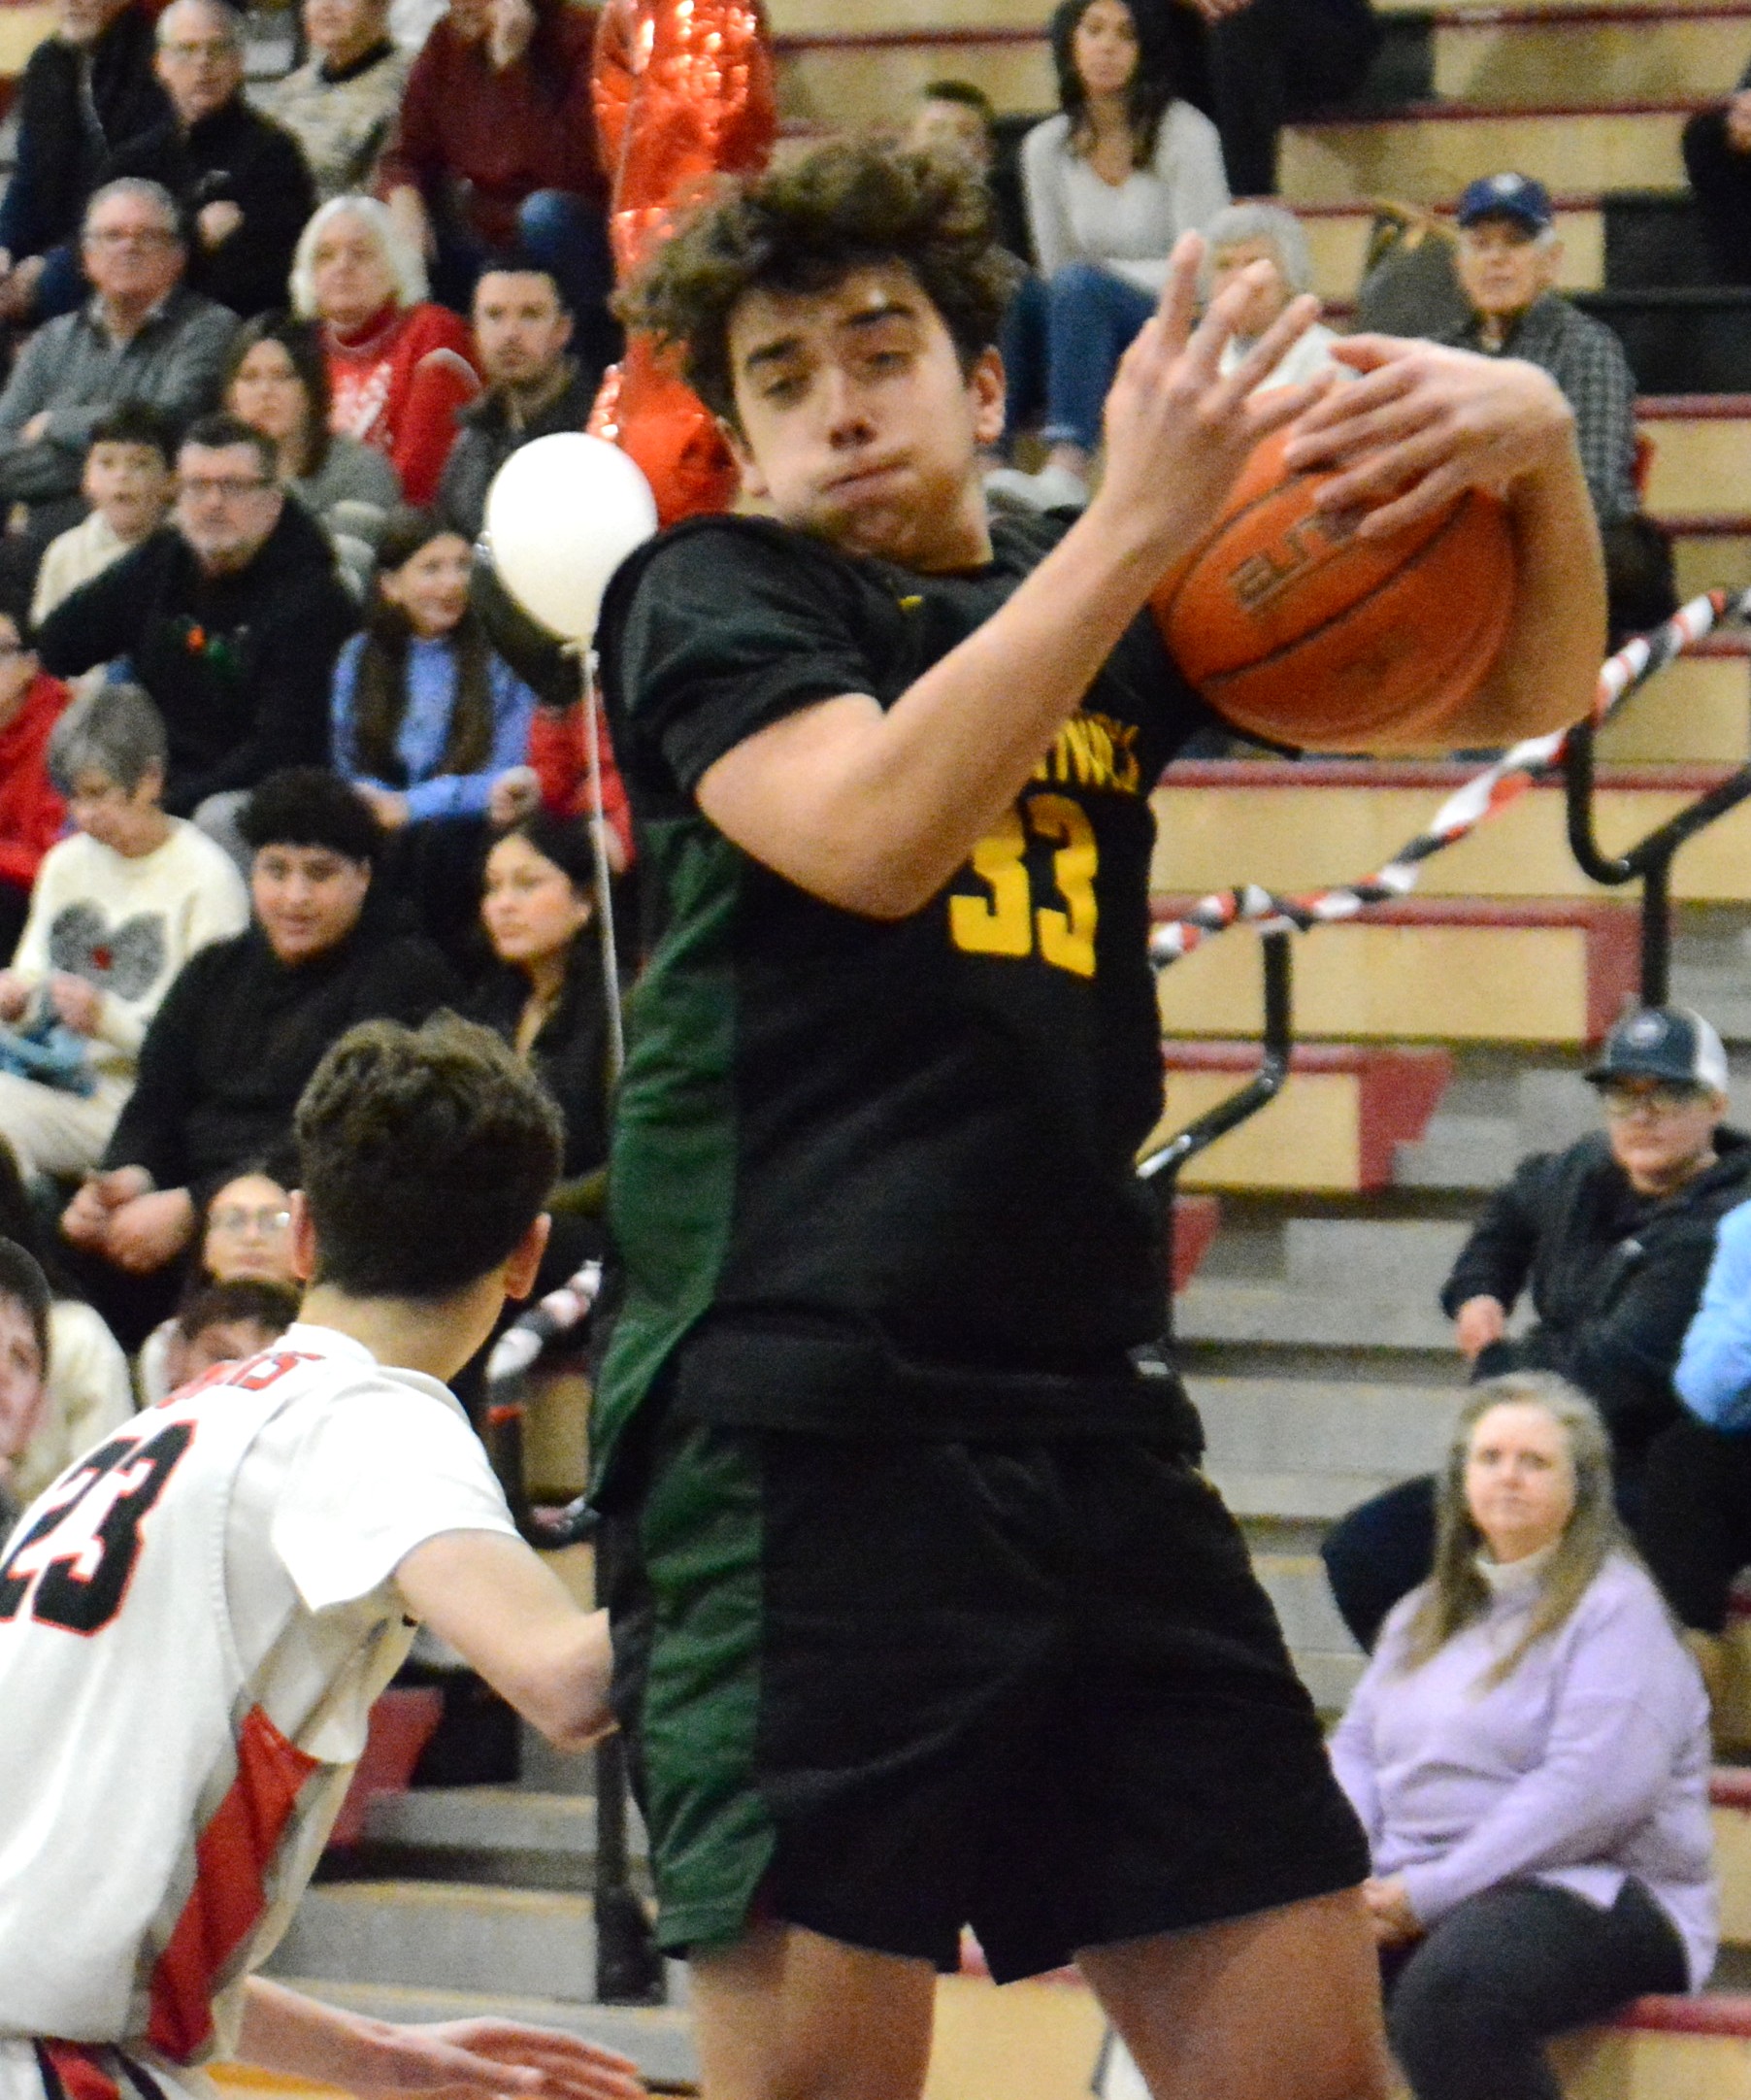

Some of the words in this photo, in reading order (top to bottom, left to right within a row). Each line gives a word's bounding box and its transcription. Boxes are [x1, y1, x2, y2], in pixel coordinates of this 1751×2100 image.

[1226, 505, 1363, 612] LITE
[948, 793, 1099, 978] 33
[0, 1418, 198, 1638] 23
